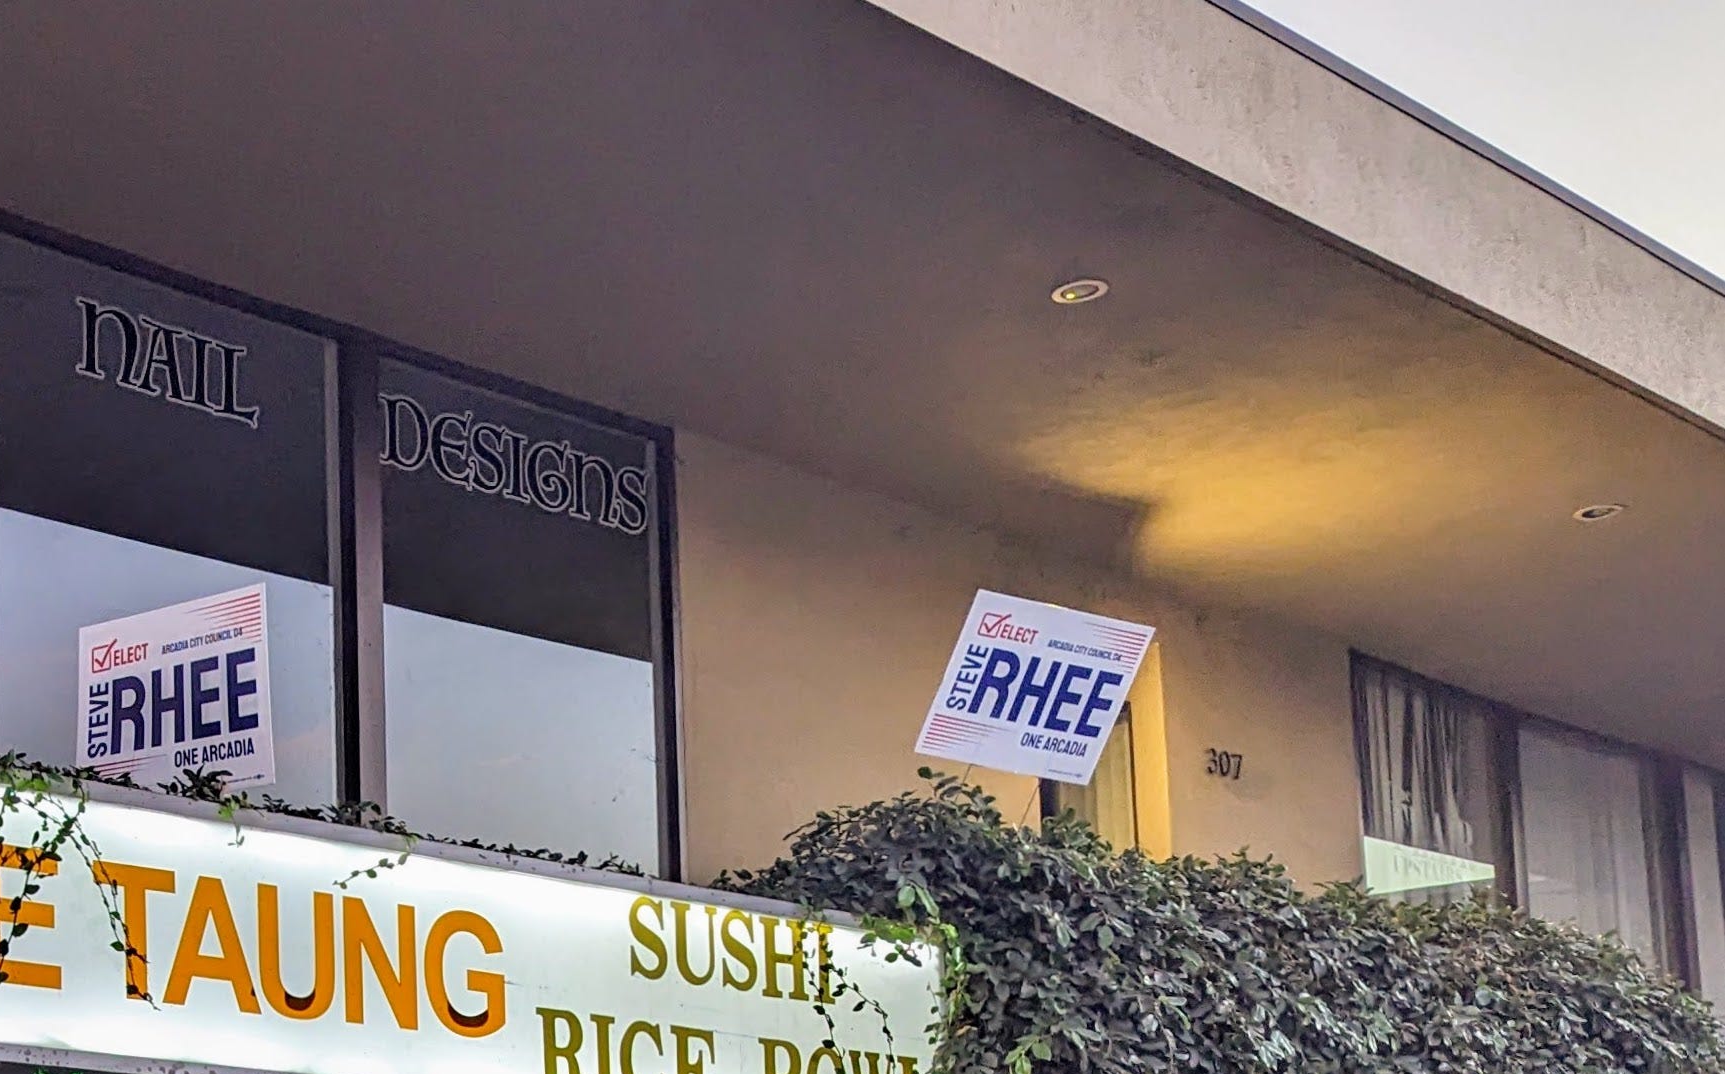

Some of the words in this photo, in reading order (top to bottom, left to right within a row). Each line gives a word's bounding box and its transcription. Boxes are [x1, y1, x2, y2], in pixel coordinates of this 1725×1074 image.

[75, 296, 260, 429] NAIL
[378, 392, 649, 535] DESIGNS
[113, 642, 149, 667] ELECT
[161, 640, 189, 655] ARCADIA
[189, 636, 205, 650] CITY
[205, 630, 232, 645] COUNCIL
[1001, 623, 1039, 645] ELECT
[1047, 638, 1075, 654] ARCADIA
[1074, 644, 1087, 656] CITY
[110, 647, 260, 755] RHEE
[946, 643, 989, 711] STEVE
[967, 647, 1125, 739] RHEE
[87, 681, 110, 759] STEVE
[174, 747, 199, 768] ONE
[201, 737, 255, 764] ARCADIA
[1020, 732, 1045, 751] ONE
[1043, 736, 1087, 758] ARCADIA
[1205, 748, 1243, 780] 307
[92, 860, 506, 1038] TAUNG
[628, 895, 836, 1005] SUSHI
